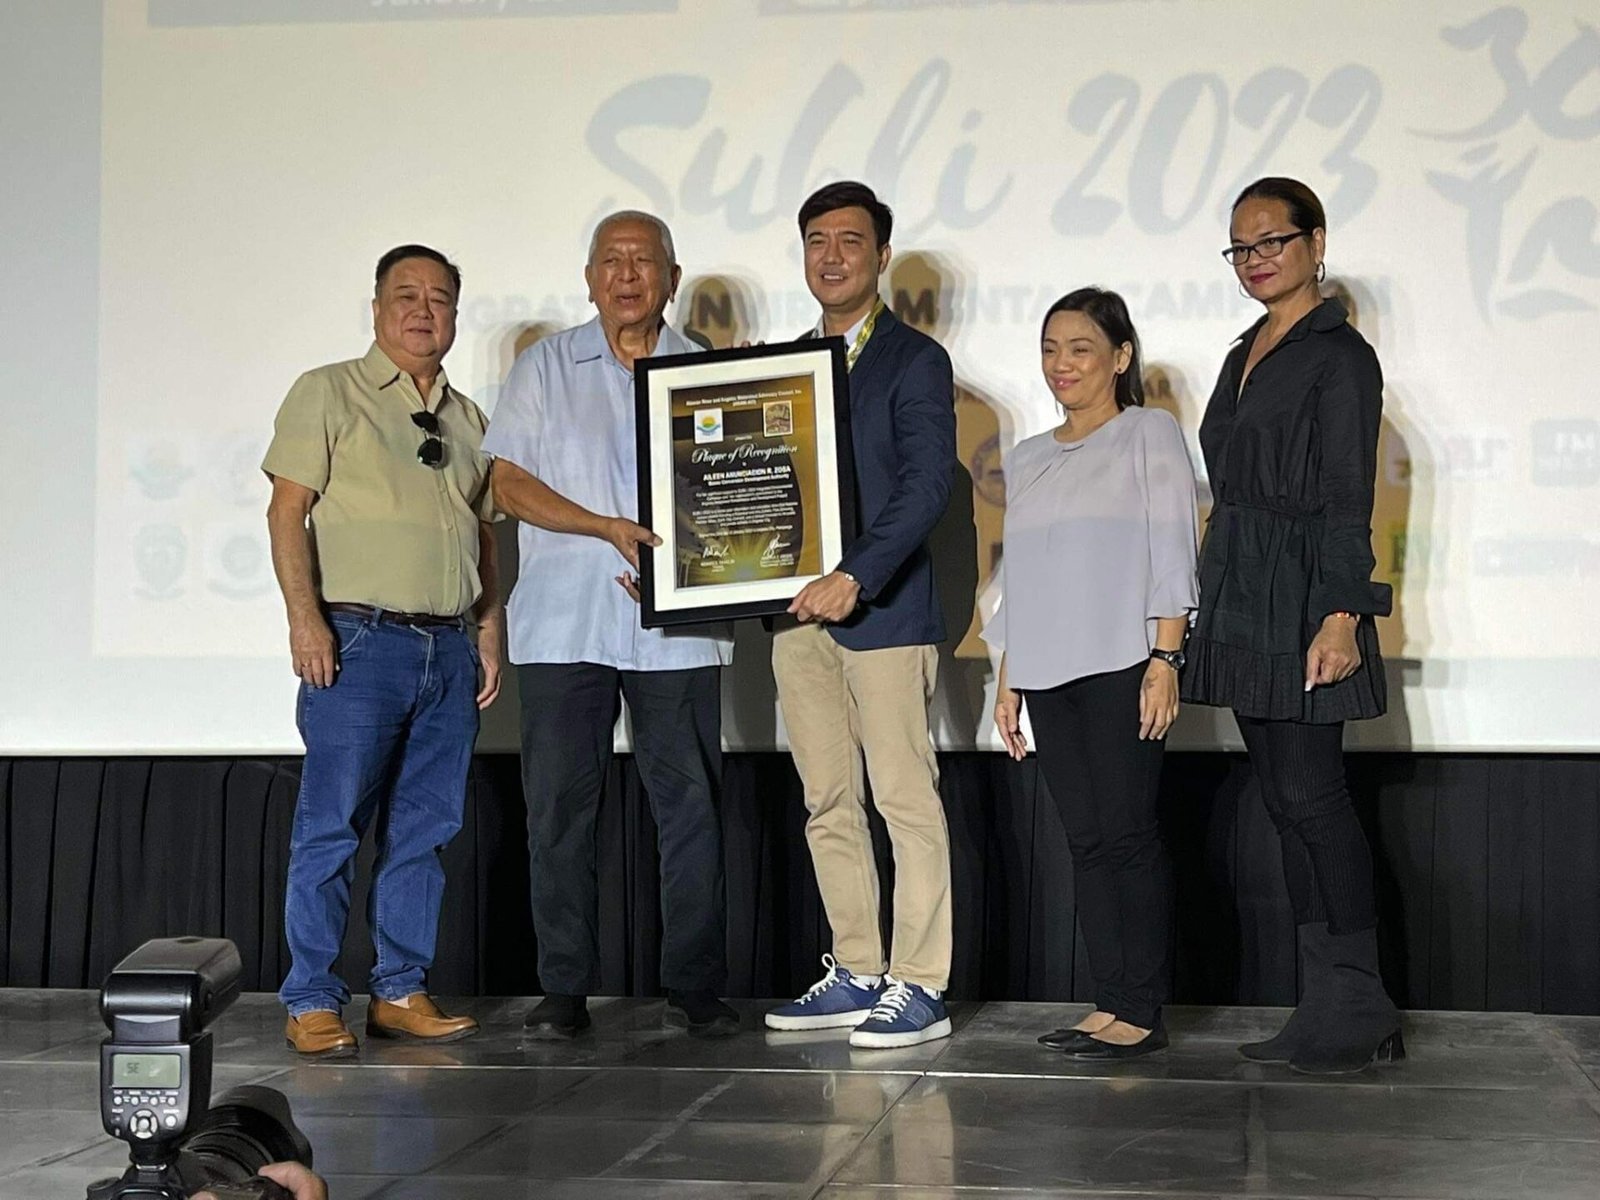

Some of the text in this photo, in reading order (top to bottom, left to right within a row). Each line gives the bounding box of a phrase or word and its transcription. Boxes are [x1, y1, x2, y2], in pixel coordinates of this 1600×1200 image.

[1051, 63, 1383, 236] 2023
[691, 443, 798, 466] Plaque of Recognition
